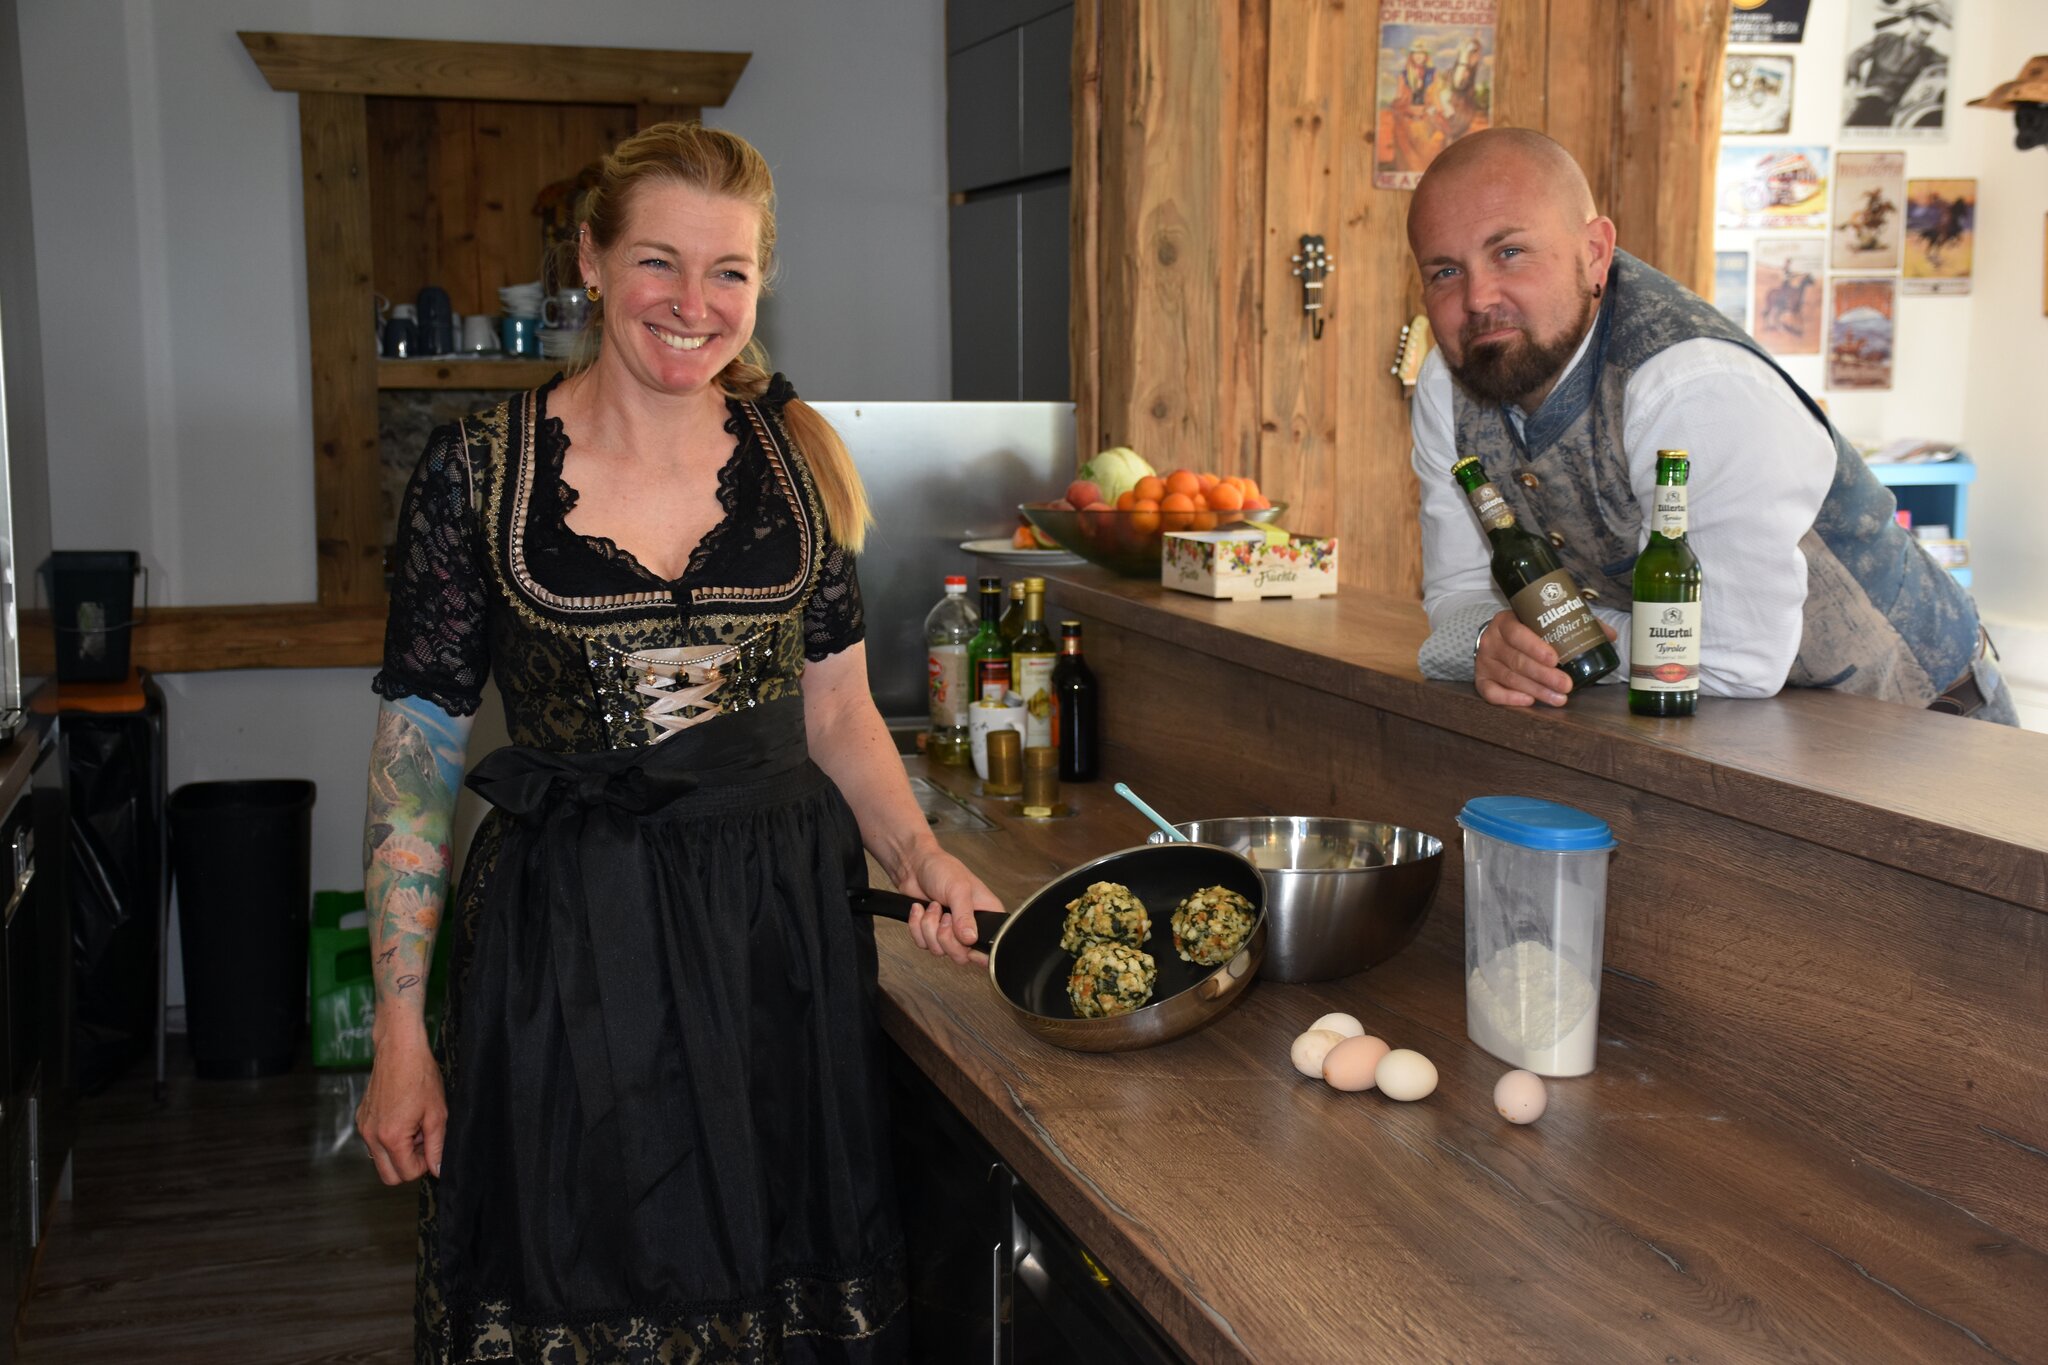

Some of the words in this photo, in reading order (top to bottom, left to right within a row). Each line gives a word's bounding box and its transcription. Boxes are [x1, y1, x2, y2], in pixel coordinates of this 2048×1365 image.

[1397, 0, 1419, 9] THE
[1422, 0, 1462, 10] WORLD
[1380, 10, 1400, 21] OF
[1405, 10, 1495, 24] PRINCESSES
[1401, 175, 1410, 187] A
[1537, 596, 1585, 629] Zillertal
[1649, 627, 1693, 638] Zillertal
[1656, 643, 1687, 655] Tyroler
